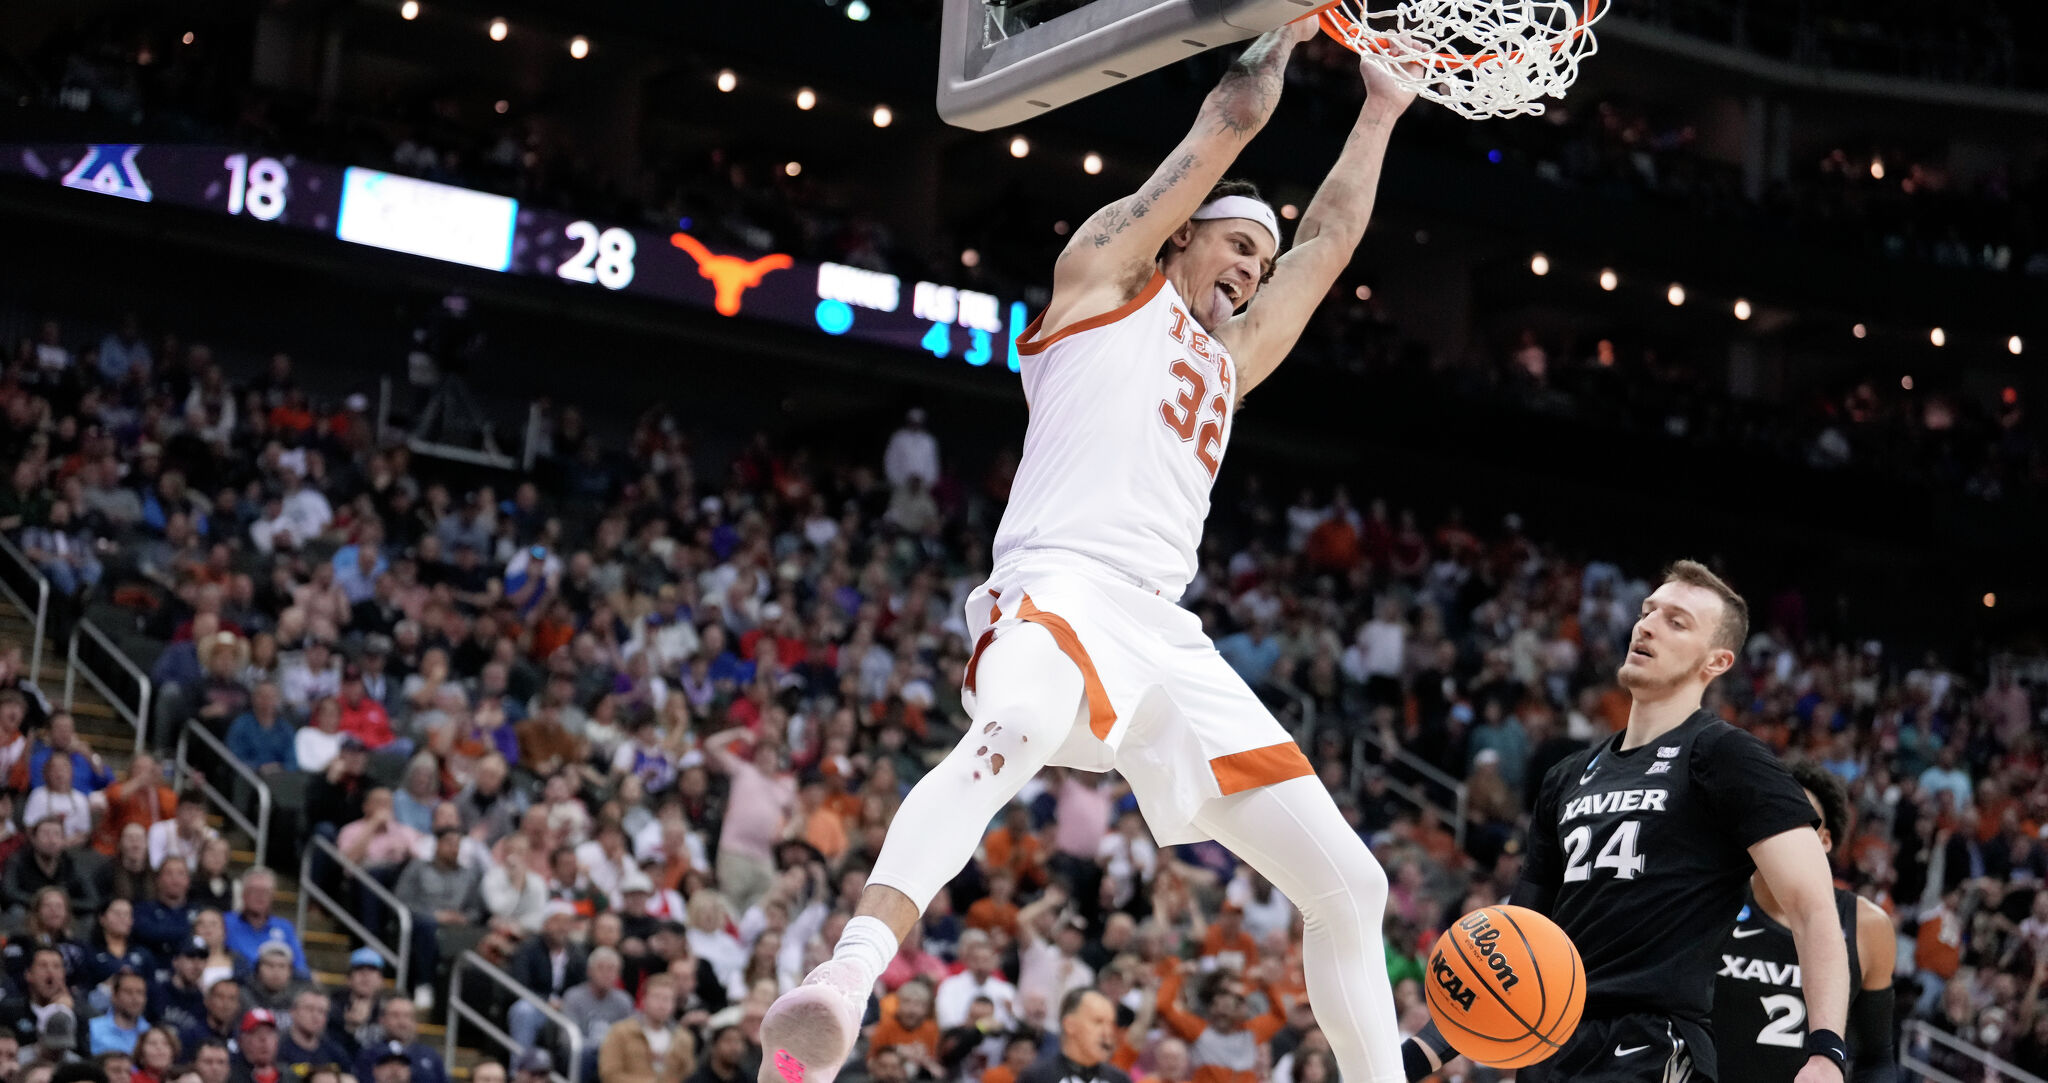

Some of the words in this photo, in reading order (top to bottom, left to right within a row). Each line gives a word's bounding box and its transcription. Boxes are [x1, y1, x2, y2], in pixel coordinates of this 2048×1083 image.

[224, 154, 289, 221] 18
[558, 221, 637, 290] 28
[1169, 302, 1230, 398] TEA
[1159, 359, 1227, 484] 32
[1559, 789, 1669, 826] XAVIER
[1563, 821, 1645, 884] 24
[1431, 948, 1477, 1012] NCAA
[1458, 911, 1519, 992] Wilson
[1717, 954, 1803, 988] XAVI
[1756, 994, 1806, 1048] 2
